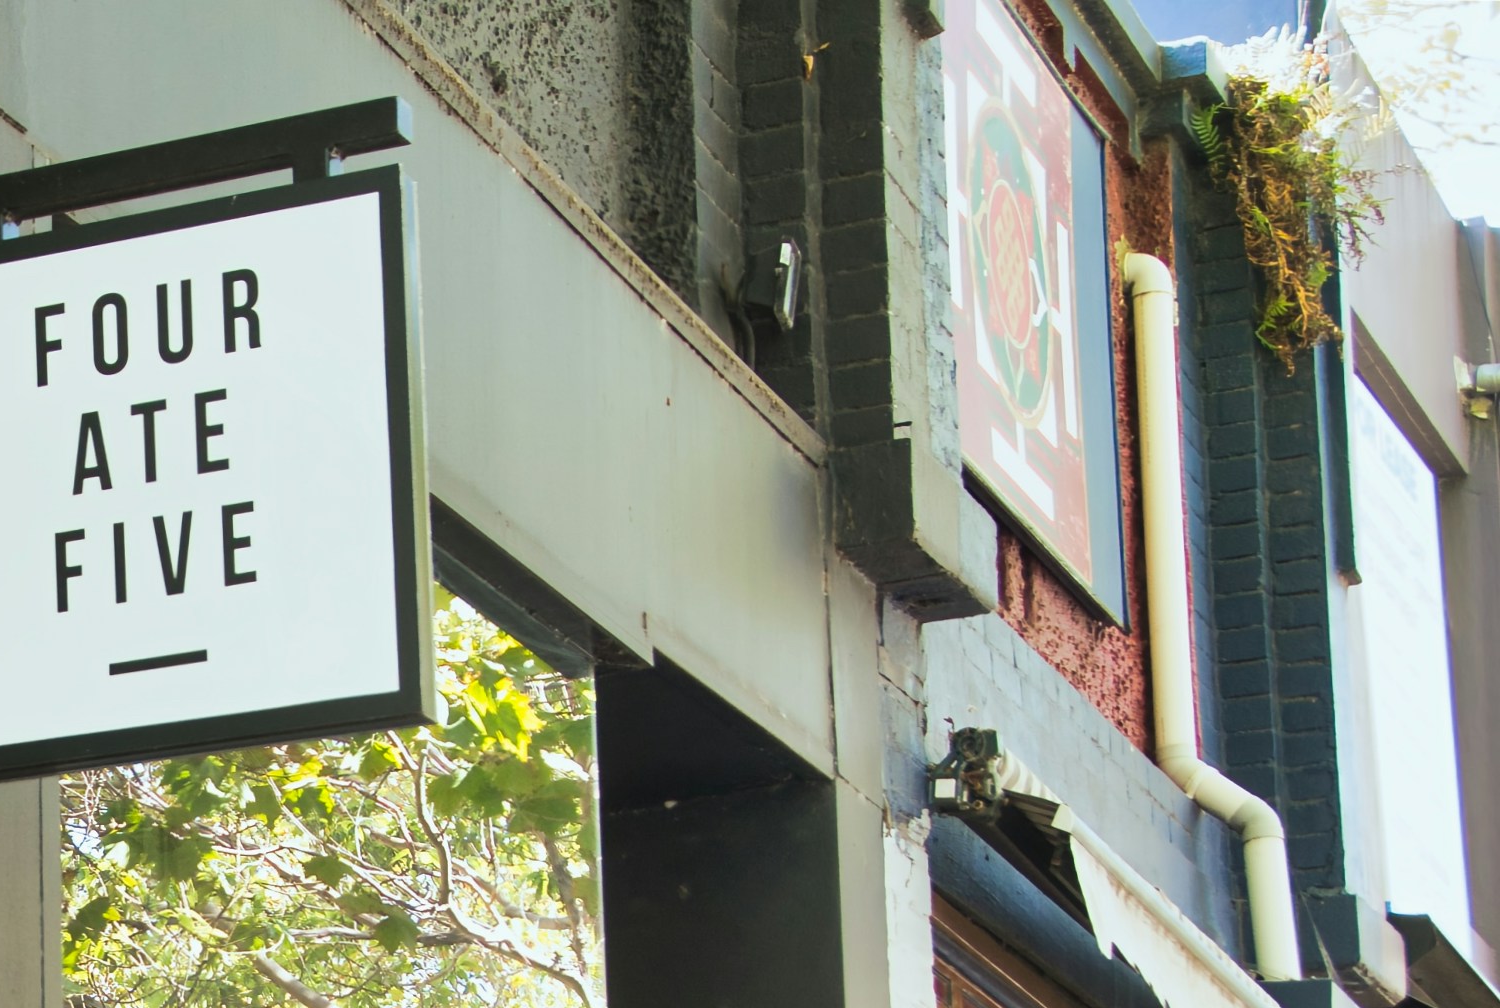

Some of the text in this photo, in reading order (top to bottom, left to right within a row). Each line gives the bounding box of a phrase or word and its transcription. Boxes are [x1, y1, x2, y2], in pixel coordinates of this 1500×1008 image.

[34, 268, 262, 388] FOUR
[72, 388, 230, 496] ATE
[54, 500, 258, 614] FIVE
